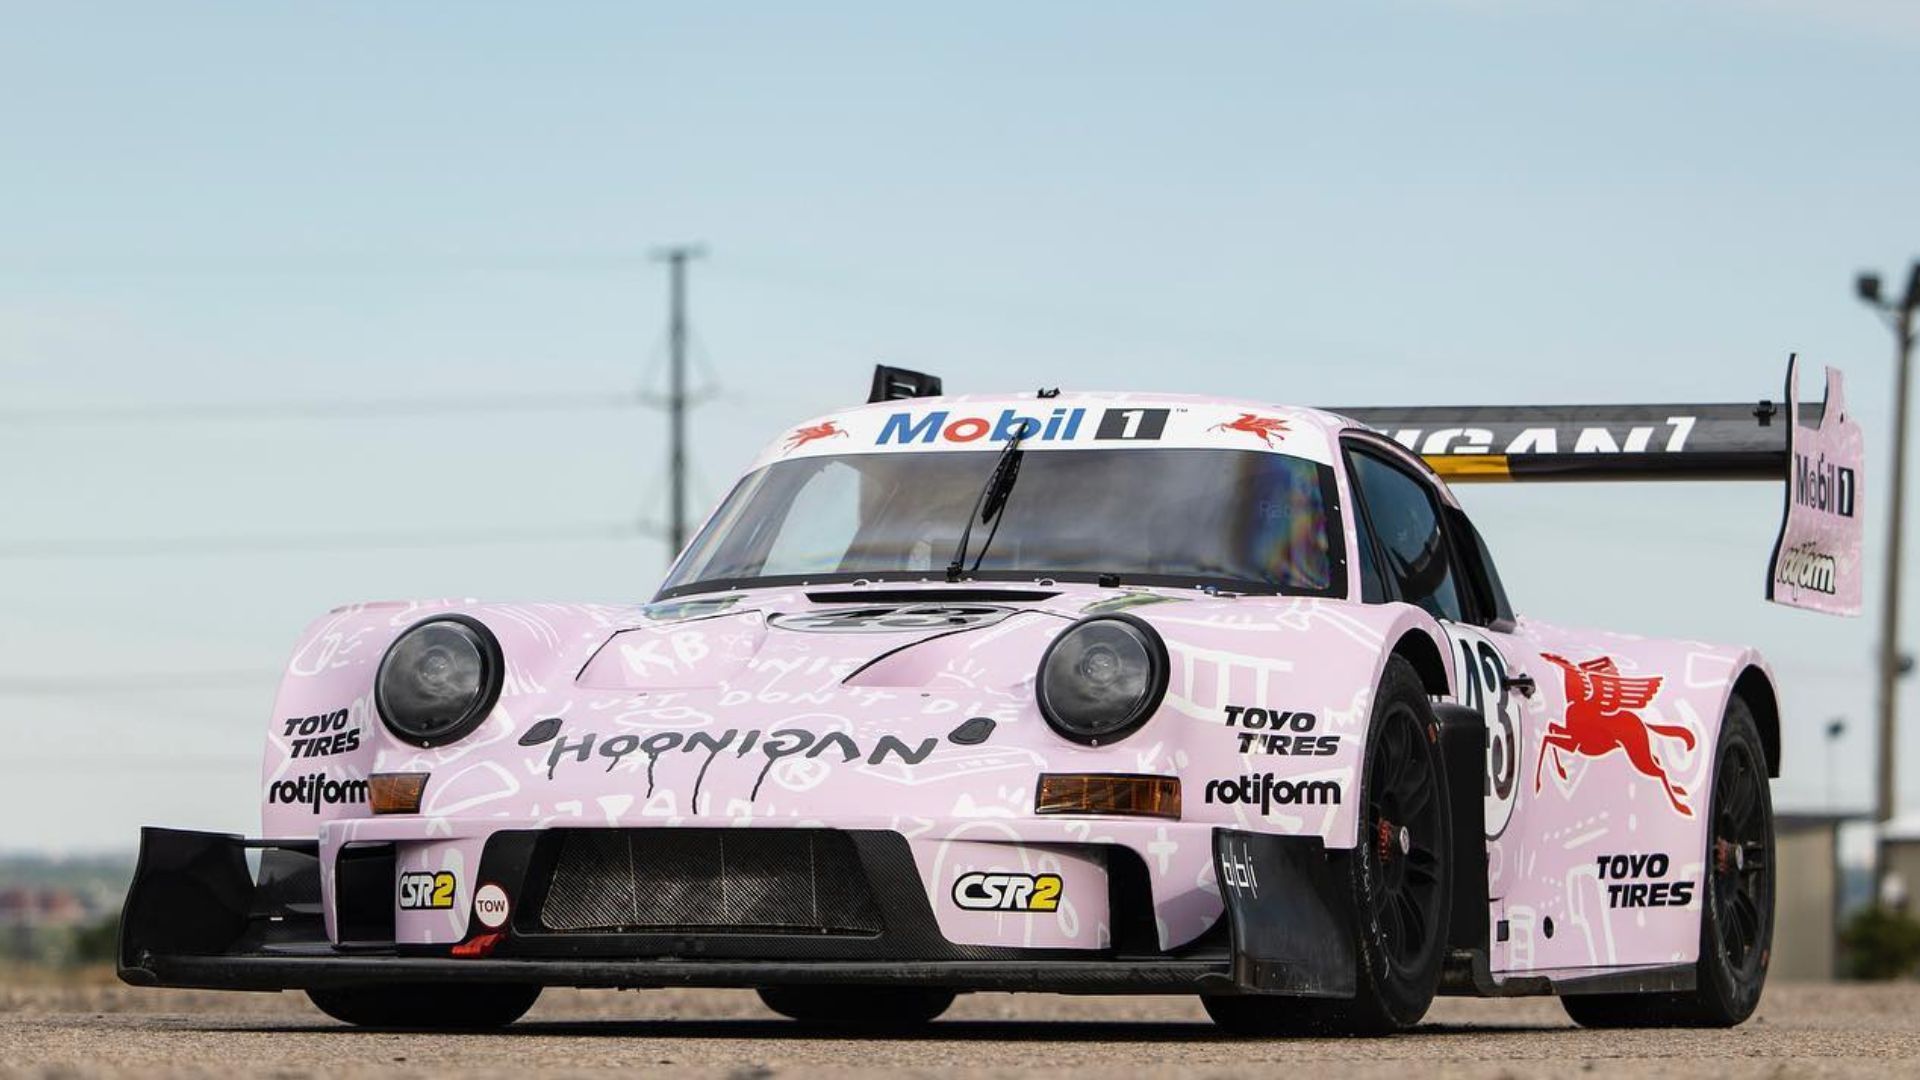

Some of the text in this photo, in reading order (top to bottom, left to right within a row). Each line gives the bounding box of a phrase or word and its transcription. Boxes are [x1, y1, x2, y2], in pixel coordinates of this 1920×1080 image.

[875, 408, 1086, 445] Mobil
[1372, 427, 1655, 454] IGAN
[1795, 453, 1834, 514] Mobil
[284, 708, 348, 736] TOYO
[1224, 705, 1316, 732] TOYO
[291, 728, 360, 758] TIRES
[547, 728, 938, 790] HOONIGAN
[269, 773, 369, 814] rotiform
[1205, 773, 1341, 816] rotiform
[1597, 853, 1670, 879] TOYO
[400, 871, 456, 910] CSR2
[477, 899, 505, 913] TOW
[952, 872, 1063, 912] CSR2
[1608, 882, 1695, 908] TIRES
